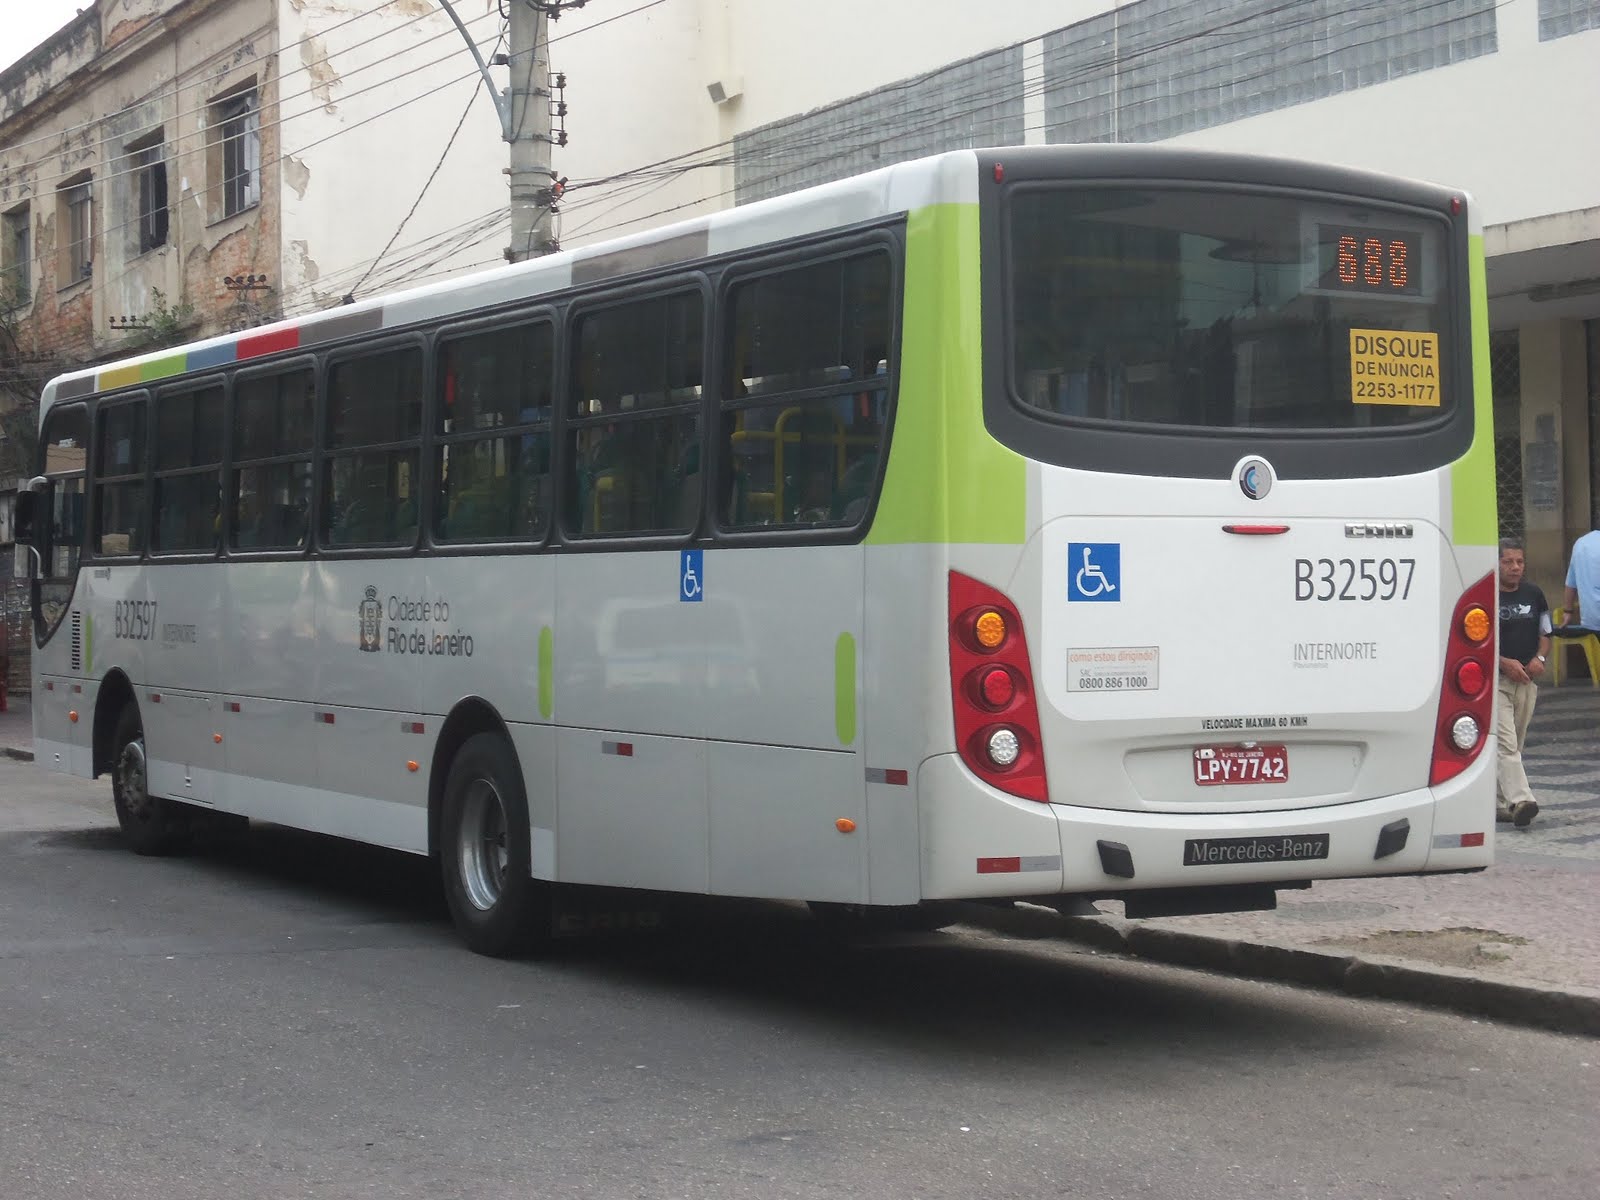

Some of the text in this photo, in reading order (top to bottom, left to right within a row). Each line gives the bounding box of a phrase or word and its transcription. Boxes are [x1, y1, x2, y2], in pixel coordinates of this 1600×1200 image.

[1339, 236, 1407, 287] 688
[1355, 335, 1433, 359] DISQUE
[1355, 359, 1435, 378] DENÚNCIA
[1356, 381, 1436, 400] 2253-1177
[1295, 558, 1416, 601] B32597
[115, 600, 157, 640] B32597
[388, 595, 449, 622] Cidade do
[388, 627, 474, 657] Rio de Janeiro
[1293, 642, 1377, 660] INTERNORTE
[1079, 676, 1148, 689] 0800 886 1000
[1201, 718, 1243, 730] VELOCIDADE
[1245, 717, 1276, 728] MAXIMA
[1278, 717, 1288, 727] 60
[1191, 838, 1324, 862] Mercedes-Benz
